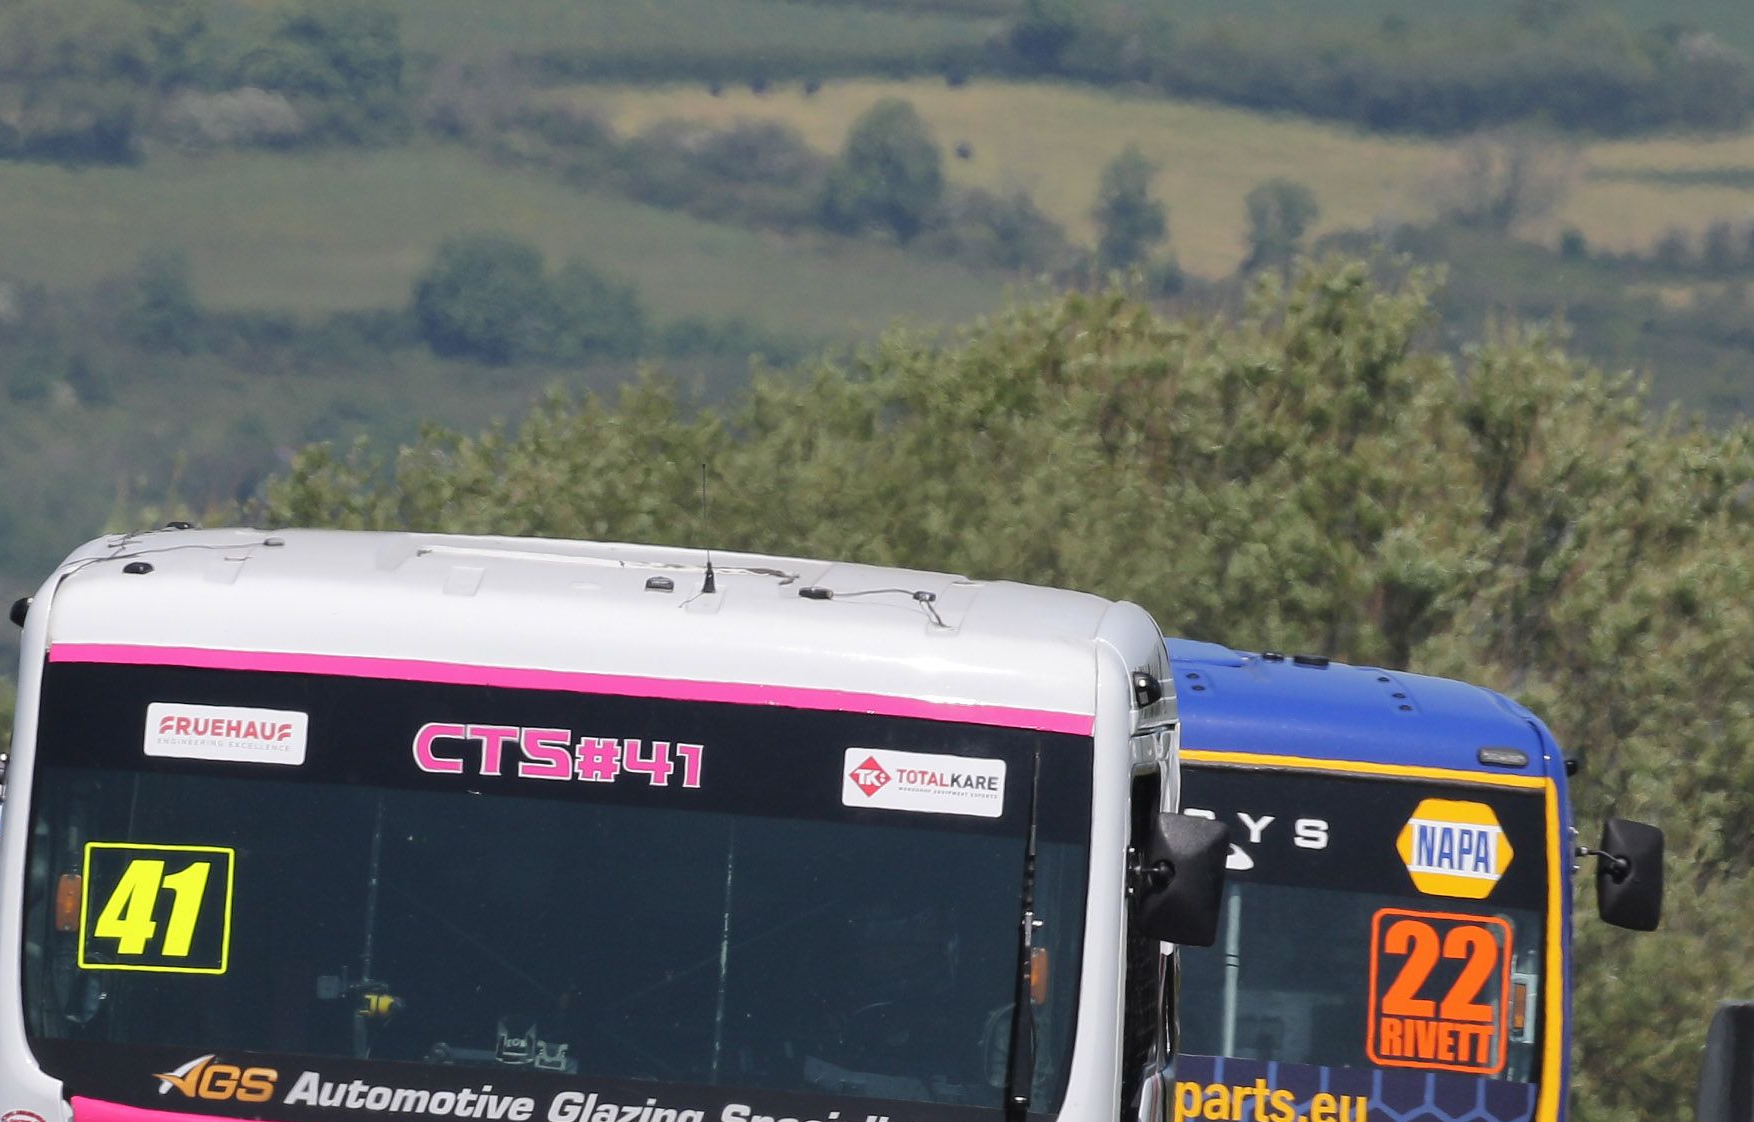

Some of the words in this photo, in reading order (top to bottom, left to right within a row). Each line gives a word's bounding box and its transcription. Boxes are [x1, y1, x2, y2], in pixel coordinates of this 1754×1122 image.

[157, 737, 224, 748] ENGINEERING
[228, 742, 290, 752] EXCELLENCE
[158, 715, 293, 742] FRUEHAUF
[413, 722, 704, 789] CTS#41
[896, 768, 999, 792] TOTALKARE
[1183, 807, 1330, 850] YS
[1417, 823, 1492, 876] NAPA
[94, 859, 210, 957] 41
[1381, 920, 1499, 1022] 22
[1380, 1016, 1496, 1064] RIVETT
[284, 1071, 536, 1122] Automotive
